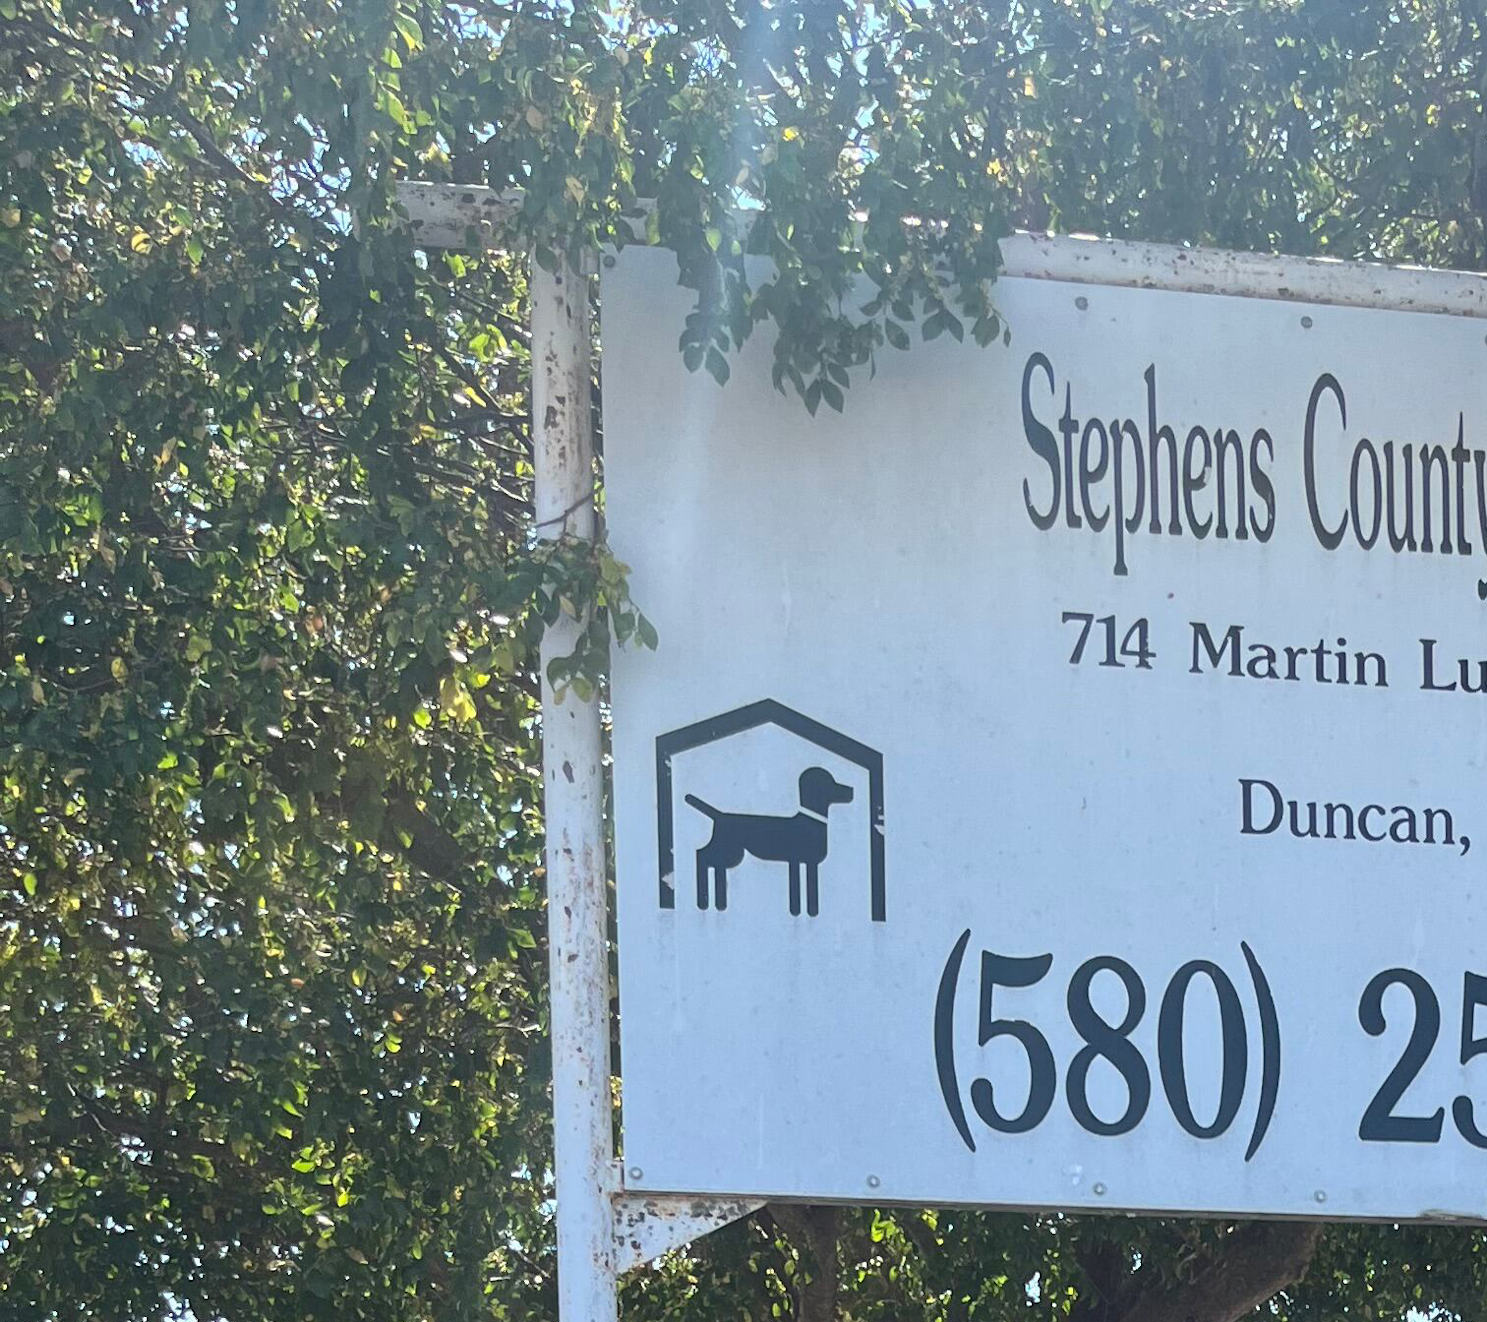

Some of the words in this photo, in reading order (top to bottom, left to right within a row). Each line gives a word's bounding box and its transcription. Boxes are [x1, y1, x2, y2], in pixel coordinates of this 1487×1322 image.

[1022, 352, 1276, 576] Stephens
[1061, 612, 1156, 670] 714
[1189, 622, 1389, 688] Martin
[1238, 779, 1471, 856] Duncan,
[934, 928, 1281, 1161] (580)
